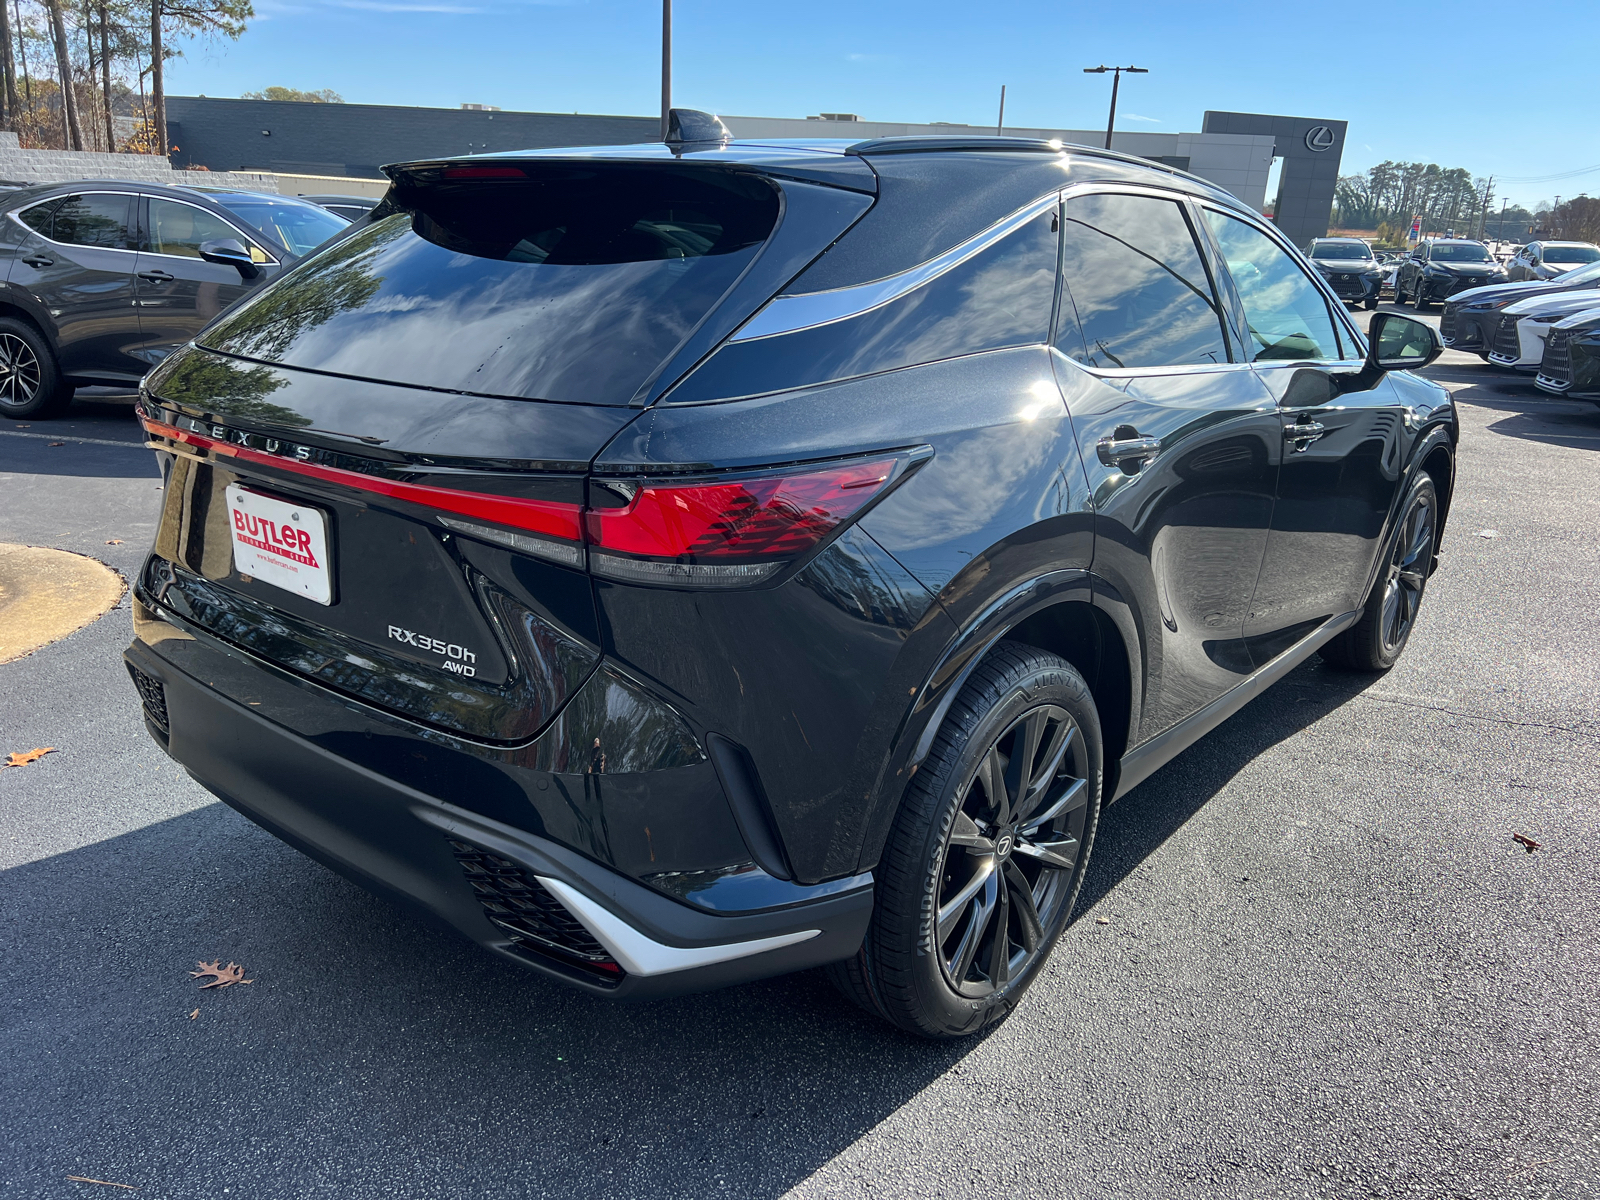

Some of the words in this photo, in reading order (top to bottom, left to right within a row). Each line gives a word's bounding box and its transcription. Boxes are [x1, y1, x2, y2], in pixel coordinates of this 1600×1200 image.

[189, 419, 311, 461] LEXUS
[290, 551, 316, 567] GROUP
[388, 624, 476, 664] RX350h
[442, 660, 476, 678] AWD
[1033, 673, 1079, 692] ALENZA
[917, 782, 965, 957] BRIDGESTONE
